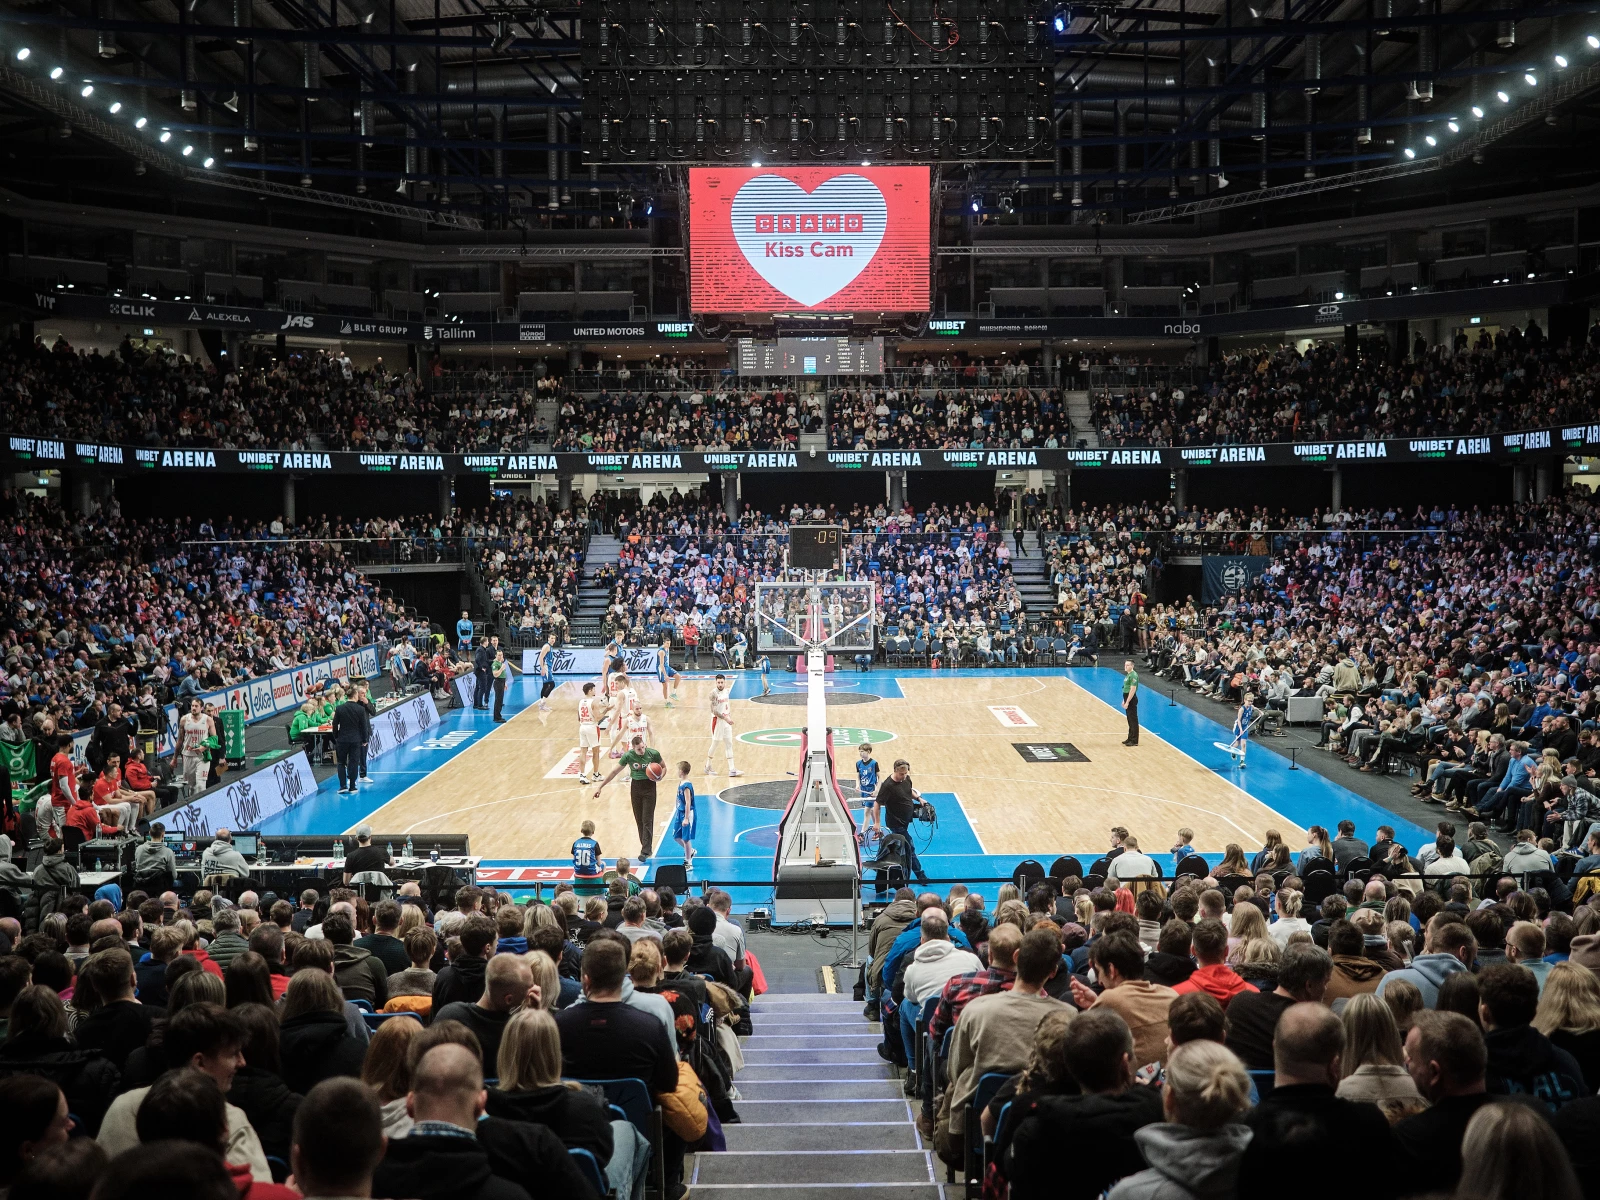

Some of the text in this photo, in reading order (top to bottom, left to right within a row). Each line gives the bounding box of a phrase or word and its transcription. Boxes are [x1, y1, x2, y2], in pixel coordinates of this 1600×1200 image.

[757, 216, 861, 231] CRAMO
[765, 242, 853, 258] Kiss Cam
[121, 304, 155, 317] CLIK
[206, 313, 251, 323] ALEXELA
[281, 314, 314, 330] JAS
[354, 323, 408, 335] BLRT GRUPP
[658, 323, 694, 333] UNIBET
[929, 321, 966, 331] UNIBET
[1164, 322, 1200, 334] naba
[436, 328, 476, 339] Tallinn
[606, 327, 645, 336] MOTORS
[1503, 431, 1550, 450] UNIBET ARENA
[1562, 427, 1585, 440] UNIBET
[10, 437, 65, 459] UNIBET ARENA
[1293, 442, 1387, 458] UNIBET ARENA
[1409, 437, 1491, 454] UNIBET ARENA
[76, 444, 123, 463] UNIBET ARENA
[136, 449, 216, 467] UNIBET ARENA
[239, 452, 331, 469] UNIBET ARENA
[704, 453, 798, 468] UNIBET ARENA
[828, 452, 922, 467] UNIBET ARENA
[943, 451, 1037, 466] UNIBET ARENA
[1068, 450, 1161, 464] UNIBET ARENA
[1181, 447, 1265, 462] UNIBET ARENA
[360, 454, 444, 470] UNIBET ARENA
[464, 455, 558, 470] UNIBET ARENA
[588, 454, 682, 469] UNIBET ARENA
[580, 706, 590, 718] 32
[575, 849, 591, 866] 30
